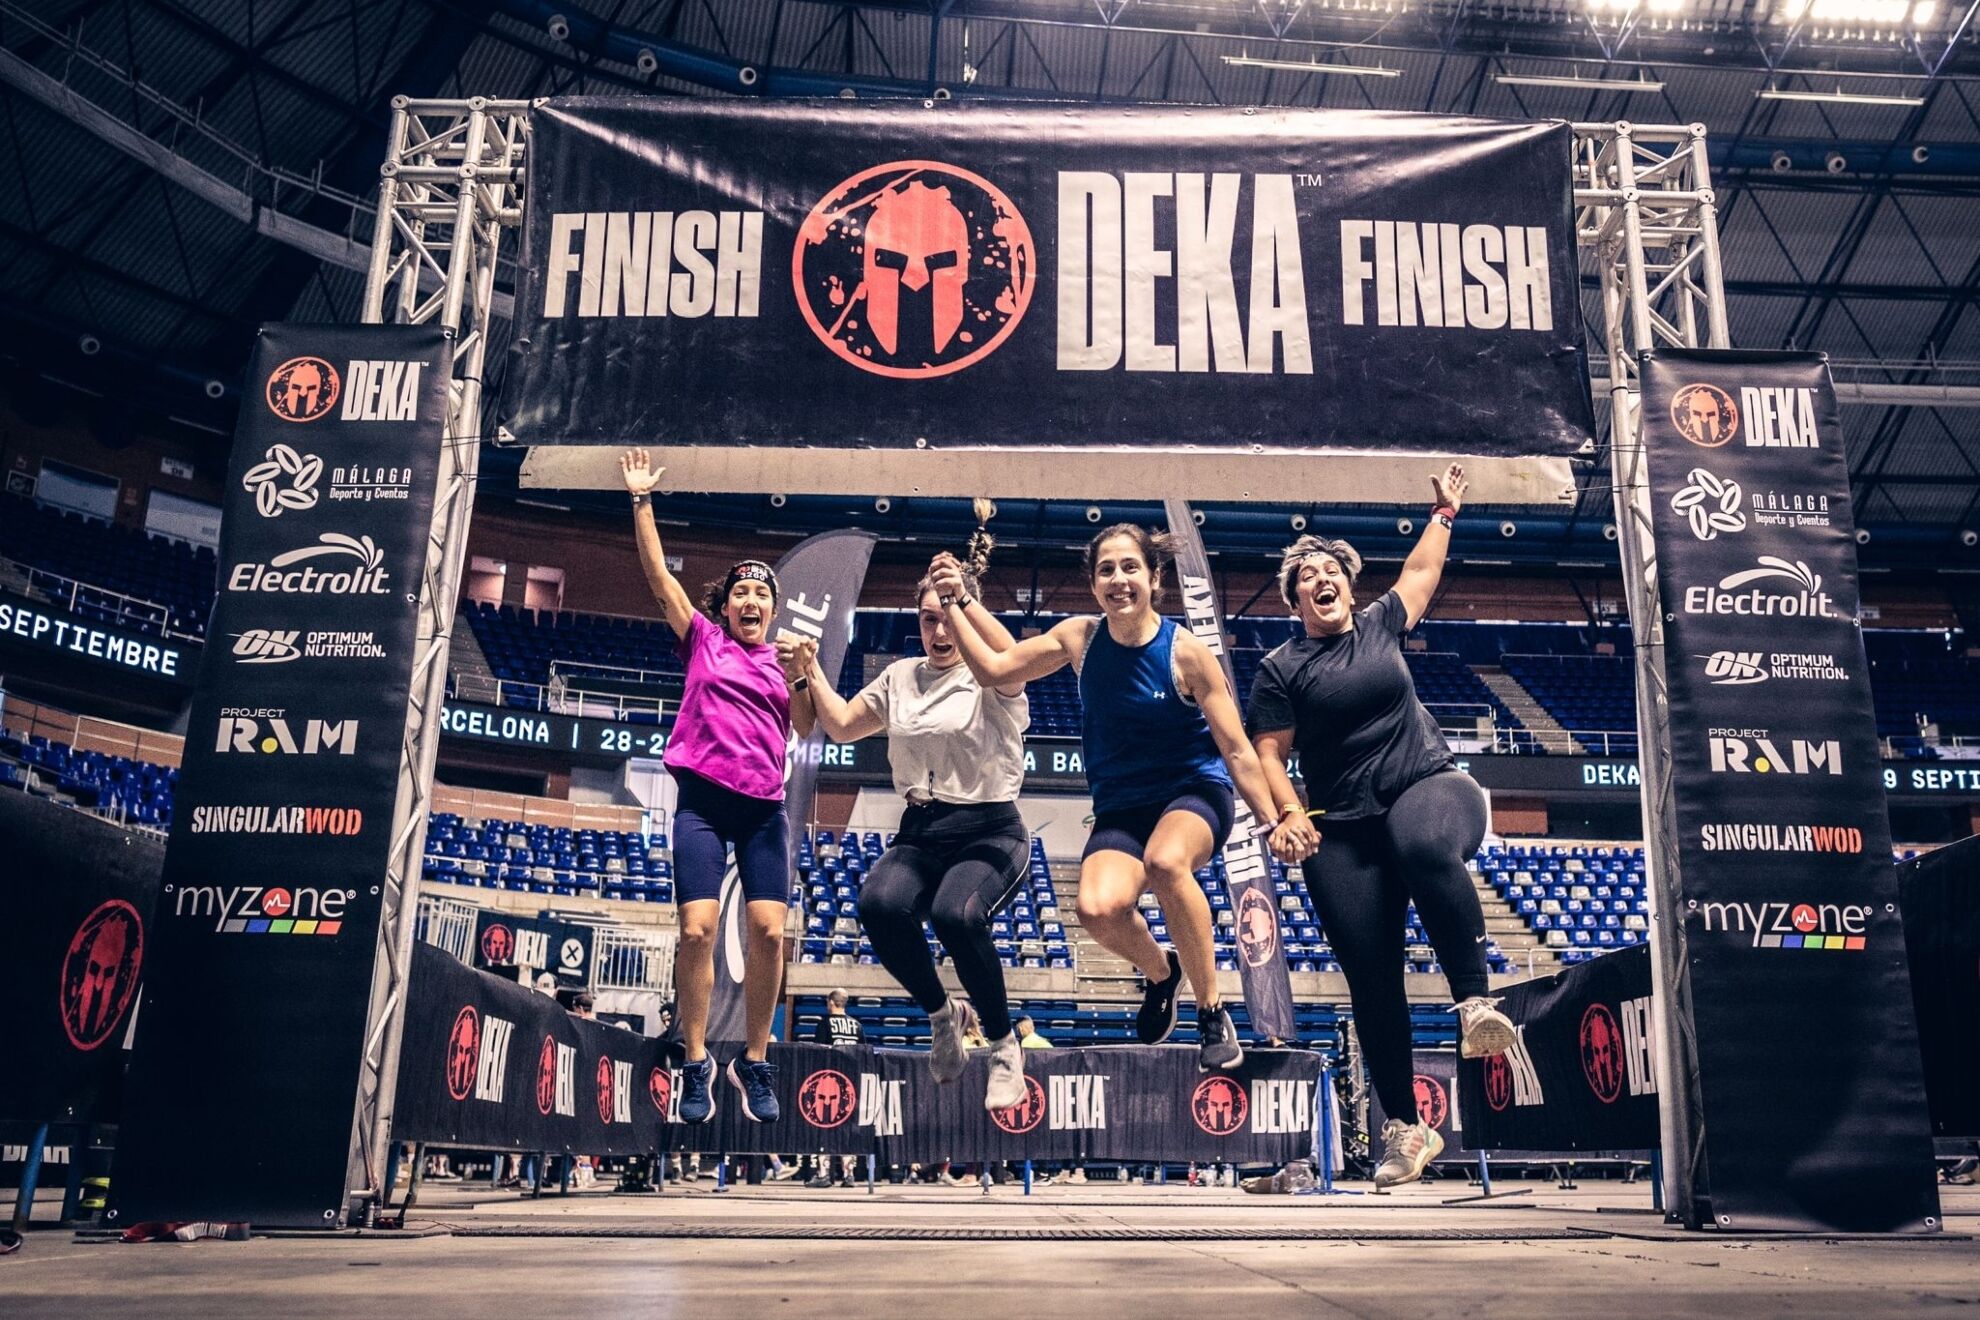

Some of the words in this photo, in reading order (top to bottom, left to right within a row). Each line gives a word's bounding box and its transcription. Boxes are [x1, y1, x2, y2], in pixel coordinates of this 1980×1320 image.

[543, 211, 764, 318] FINISH
[1057, 171, 1314, 374] DEKA
[1340, 219, 1553, 332] FINISH
[341, 360, 421, 421] DEKA
[1740, 386, 1820, 448] DEKA
[331, 464, 412, 484] MÁLAGA
[329, 487, 364, 501] Deporte
[366, 490, 372, 501] y
[374, 488, 409, 499] Eventos
[1752, 490, 1829, 511] MÁLAGA
[1754, 512, 1787, 526] Deporte
[1788, 517, 1795, 527] y
[1796, 514, 1830, 526] Eventos
[0, 604, 179, 676] SEPTIEMBRE
[231, 629, 301, 663] ON
[306, 631, 374, 645] OPTIMUM
[1704, 650, 1769, 685] ON
[1770, 653, 1834, 667] OPTIMUM
[221, 707, 286, 719] PROJECT
[215, 717, 359, 755] RAM
[440, 706, 549, 744] RCELONA
[600, 728, 672, 756] 28-2
[1708, 727, 1769, 739] PROJECT
[1053, 752, 1086, 773] BA
[1709, 737, 1843, 776] RAM
[1582, 764, 1641, 785] DEKA
[1883, 768, 1897, 789] 9
[1911, 768, 1980, 790] SEPTI
[829, 1017, 859, 1035] STAFF
[1049, 1074, 1106, 1131] DEKA
[1251, 1079, 1309, 1134] DEKA
